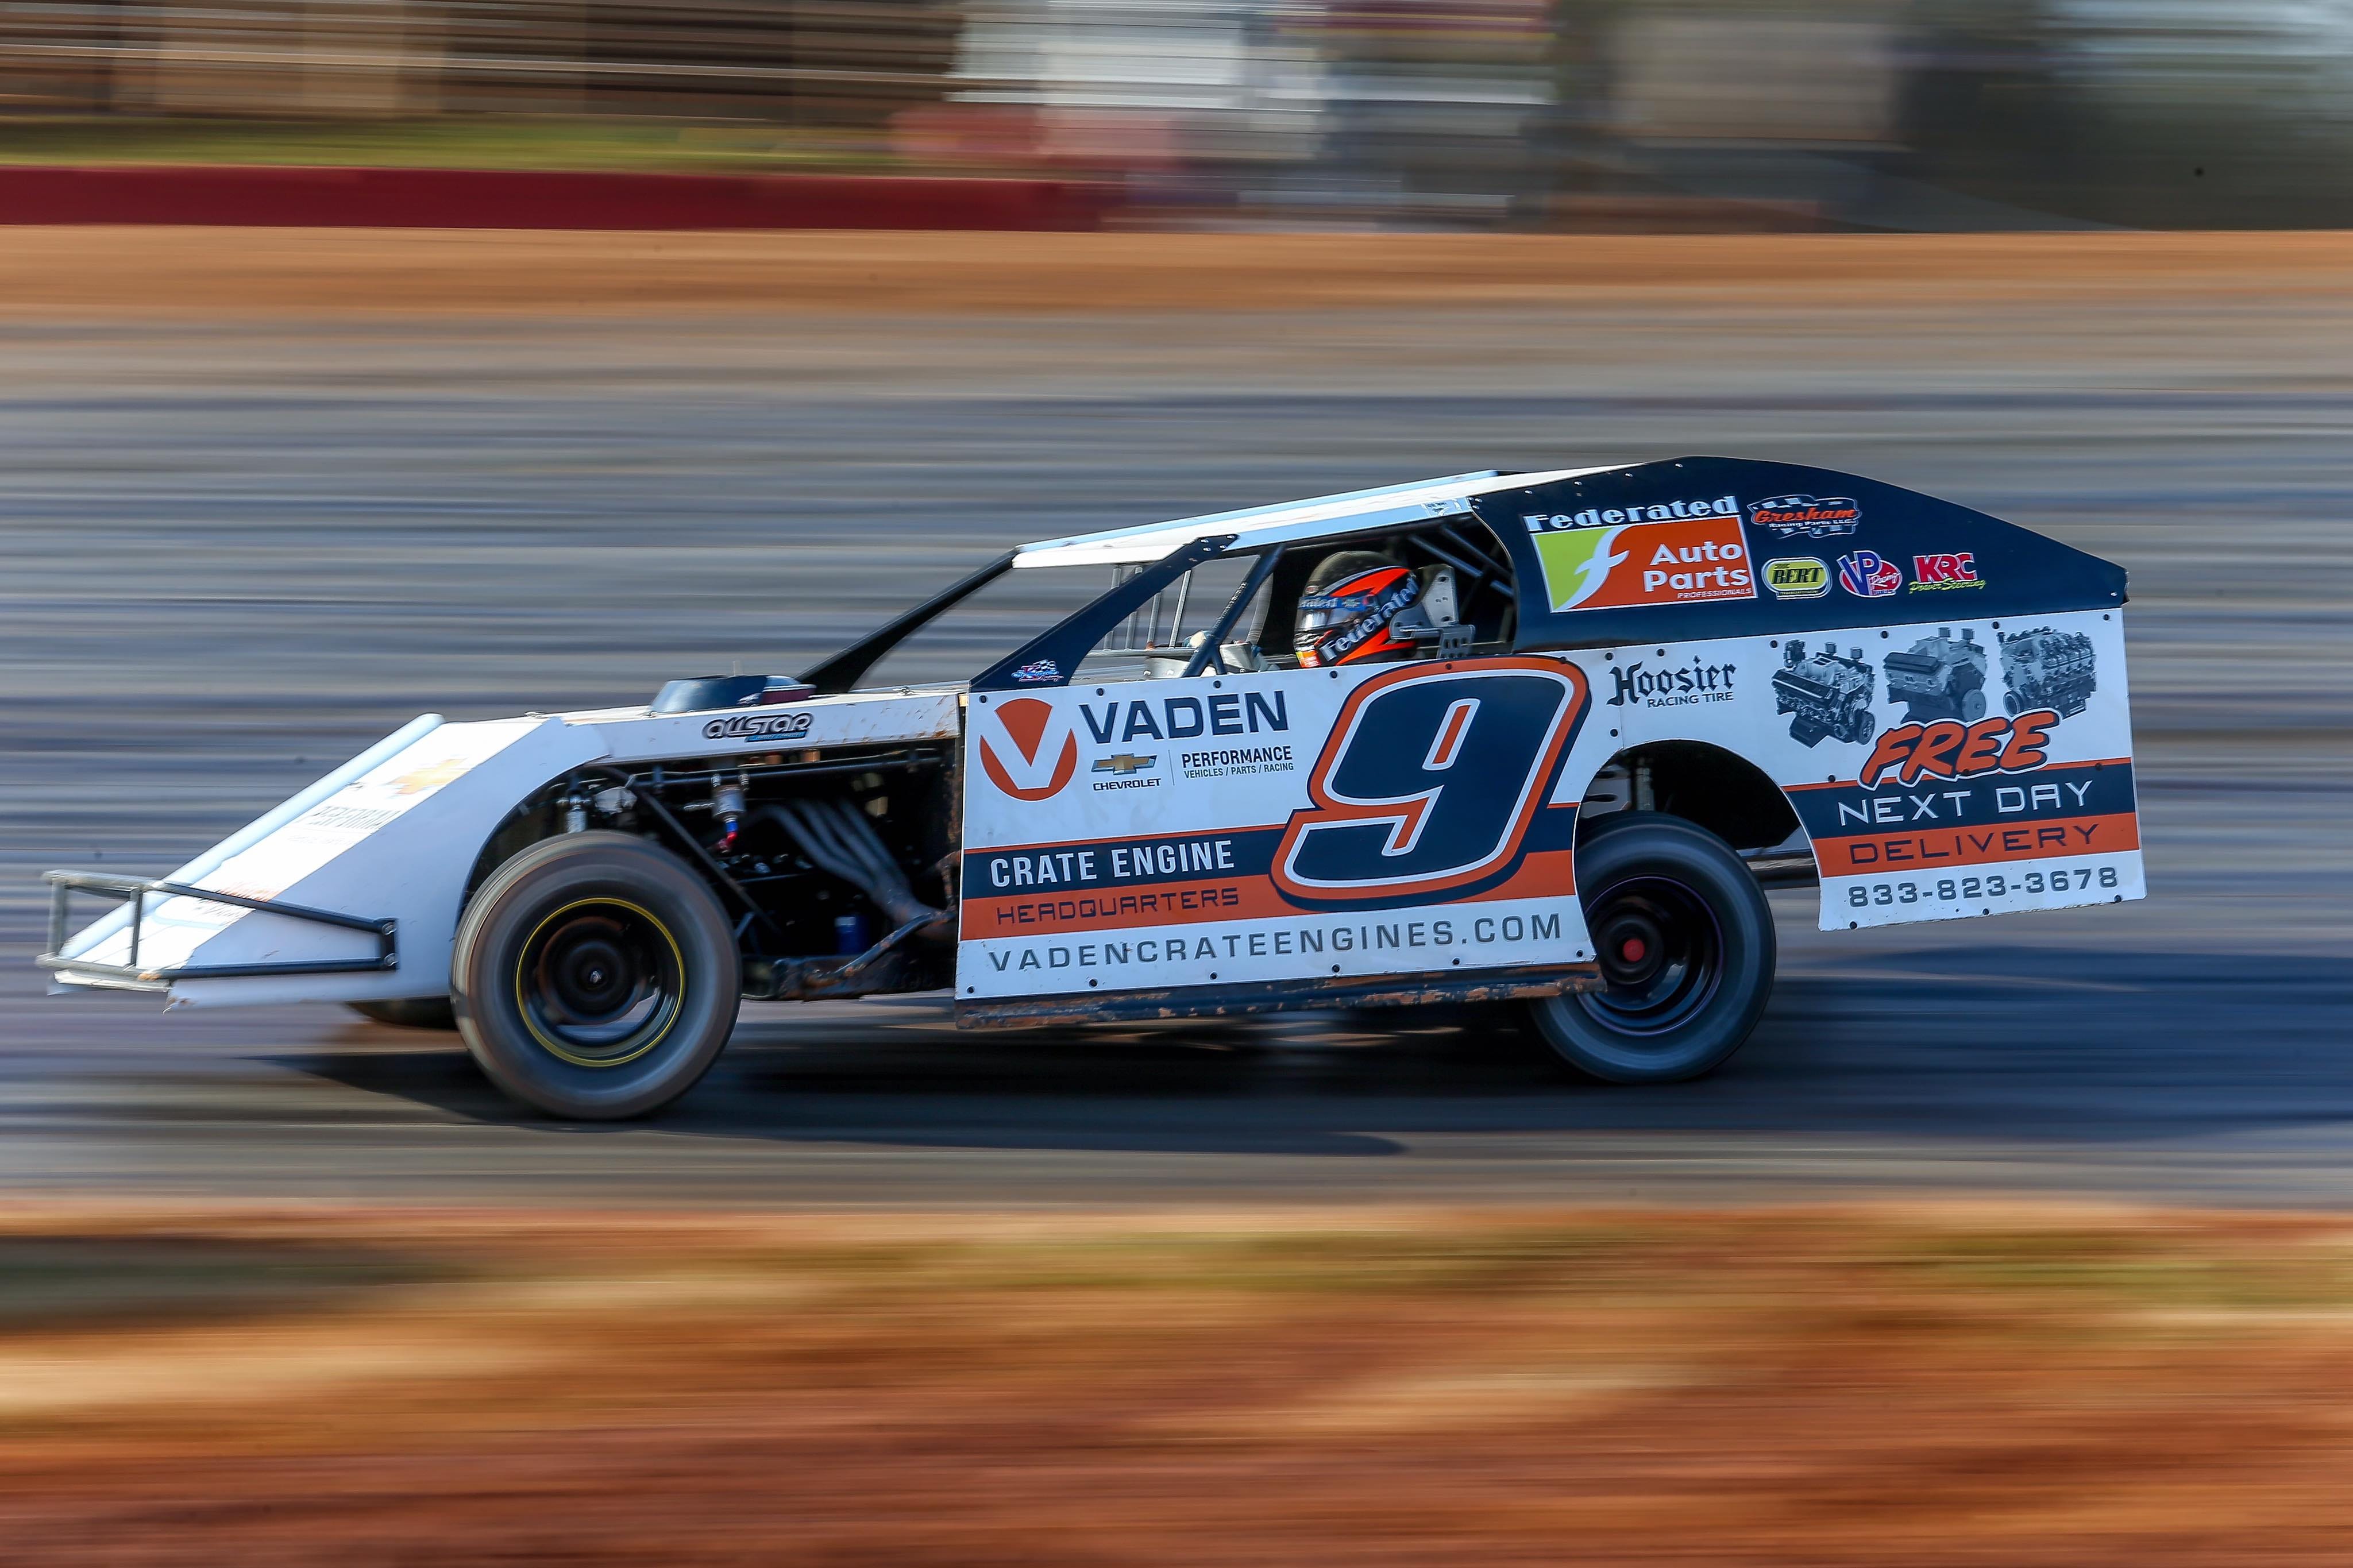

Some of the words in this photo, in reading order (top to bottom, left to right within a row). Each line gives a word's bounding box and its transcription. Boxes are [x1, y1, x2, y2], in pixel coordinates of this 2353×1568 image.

[1523, 496, 1739, 531] Federated
[1755, 507, 1856, 523] Gresham
[1650, 540, 1743, 566] Auto
[1913, 553, 1977, 584] KRC
[1643, 566, 1750, 592] Parts
[1772, 567, 1824, 584] BERT
[1837, 550, 1881, 596] VP
[1677, 588, 1752, 598] PROFESSIONALS
[1606, 655, 1737, 706] Hoosier
[1079, 690, 1289, 744] VADEN
[1647, 694, 1699, 708] RACING
[1702, 692, 1734, 703] TIRE
[1182, 746, 1293, 768] PERFORMANCE
[1858, 709, 2061, 789] FREE
[1093, 778, 1161, 791] CHEVROLET
[1184, 768, 1224, 778] VEHICLES
[1231, 765, 1256, 775] PARTS
[1264, 762, 1294, 773] RACING
[1271, 654, 1592, 912] 9
[1838, 790, 1972, 826] NEXT
[1996, 780, 2093, 813] DAY
[1850, 824, 2099, 864] DELIVERY
[990, 851, 1097, 888] CRATE
[1111, 840, 1235, 878] ENGINE
[1849, 867, 2119, 907] 833-823-3678
[997, 887, 1239, 925] HEADQUARTERS
[989, 913, 1561, 972] VADENCRATEENGINES.COM
